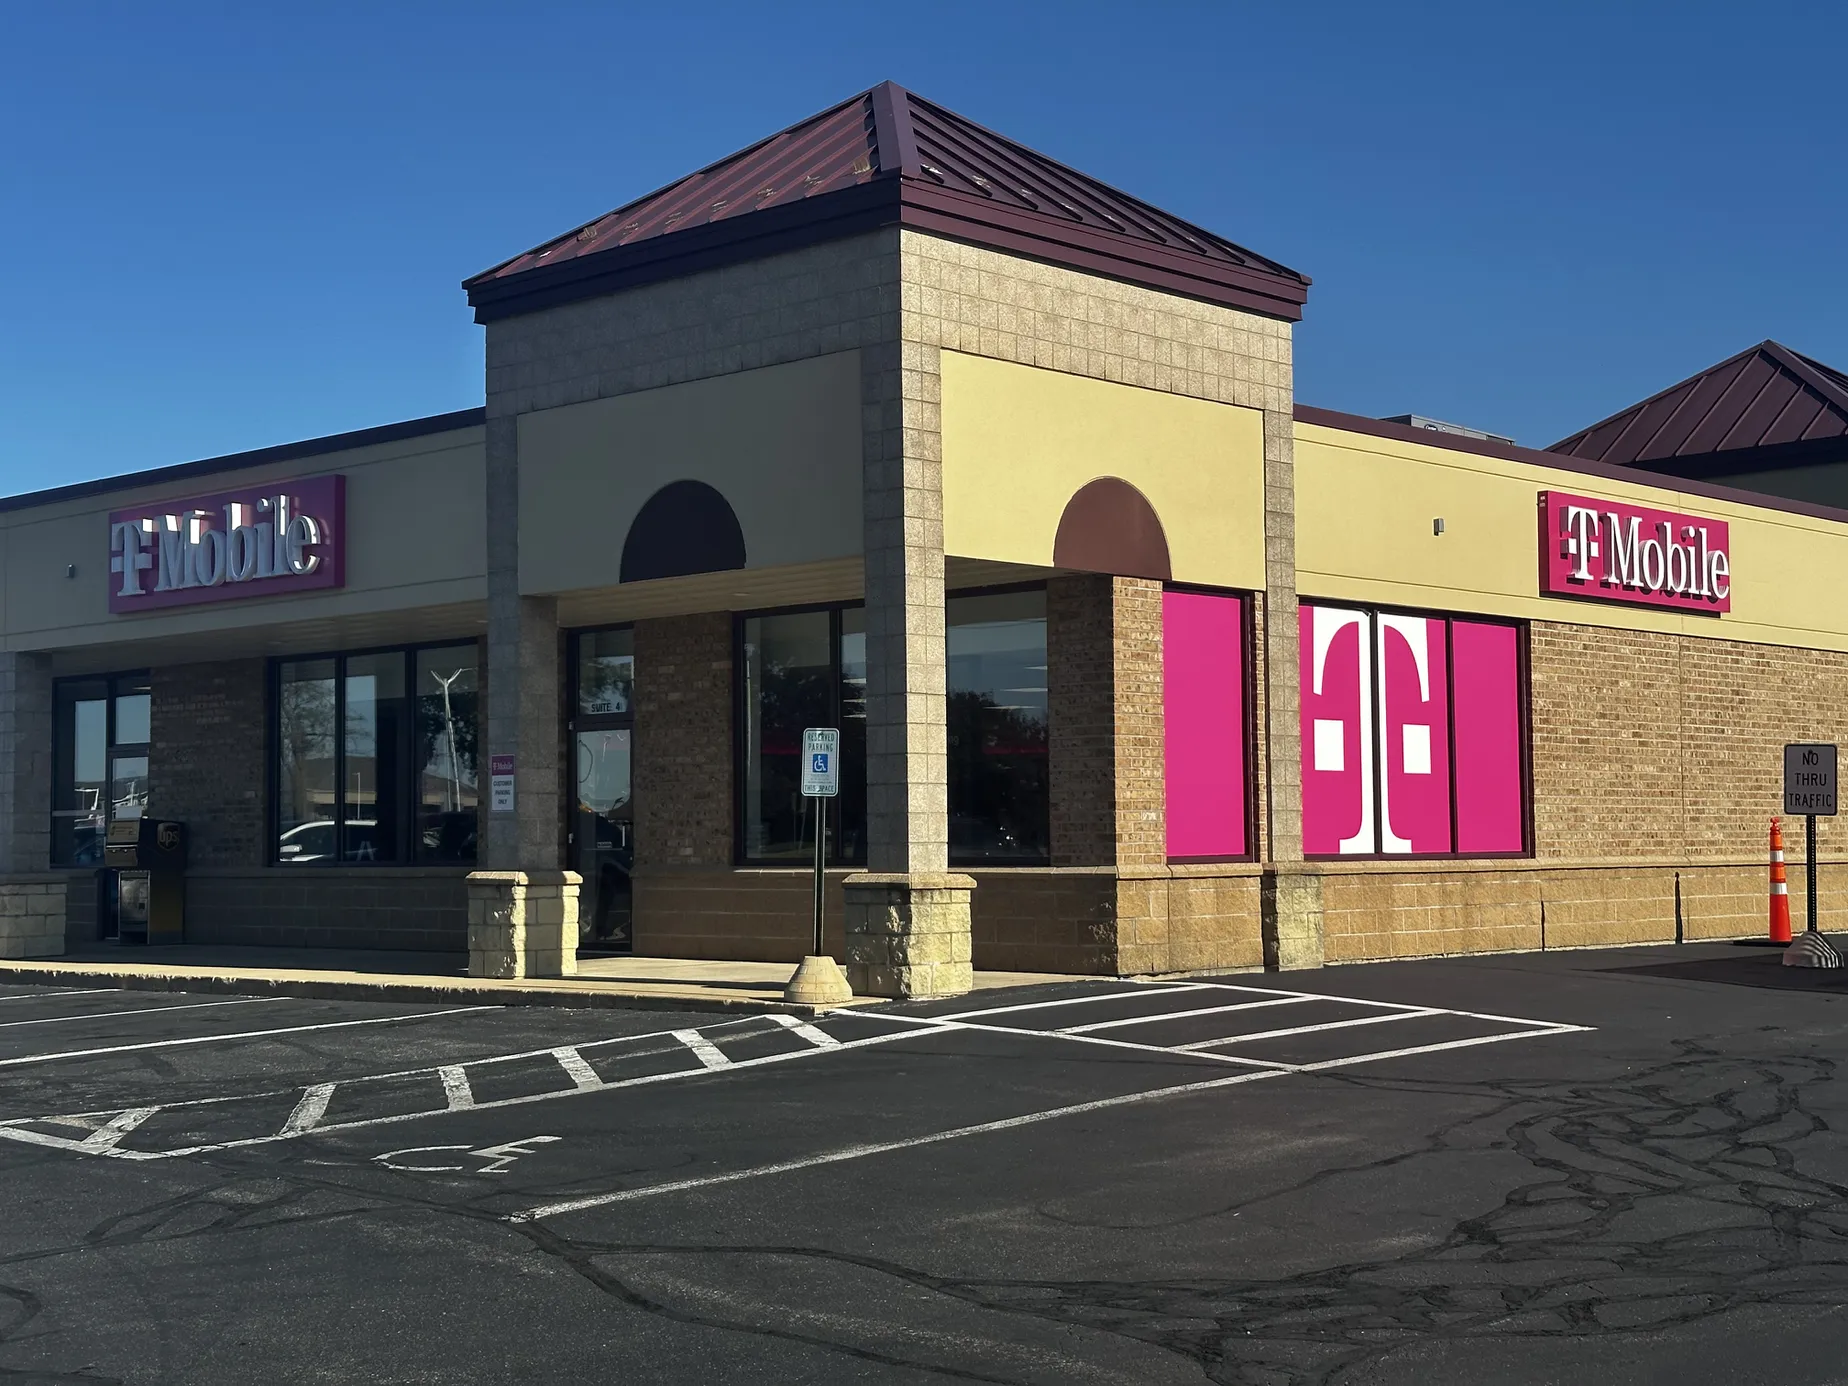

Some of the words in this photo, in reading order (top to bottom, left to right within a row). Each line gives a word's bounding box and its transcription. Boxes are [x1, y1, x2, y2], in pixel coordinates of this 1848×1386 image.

[807, 732, 835, 741] RESERVED
[808, 742, 834, 752] PARKING
[1802, 751, 1819, 766] NO
[1795, 772, 1827, 787] THRU
[1789, 793, 1832, 808] TRAFFIC
